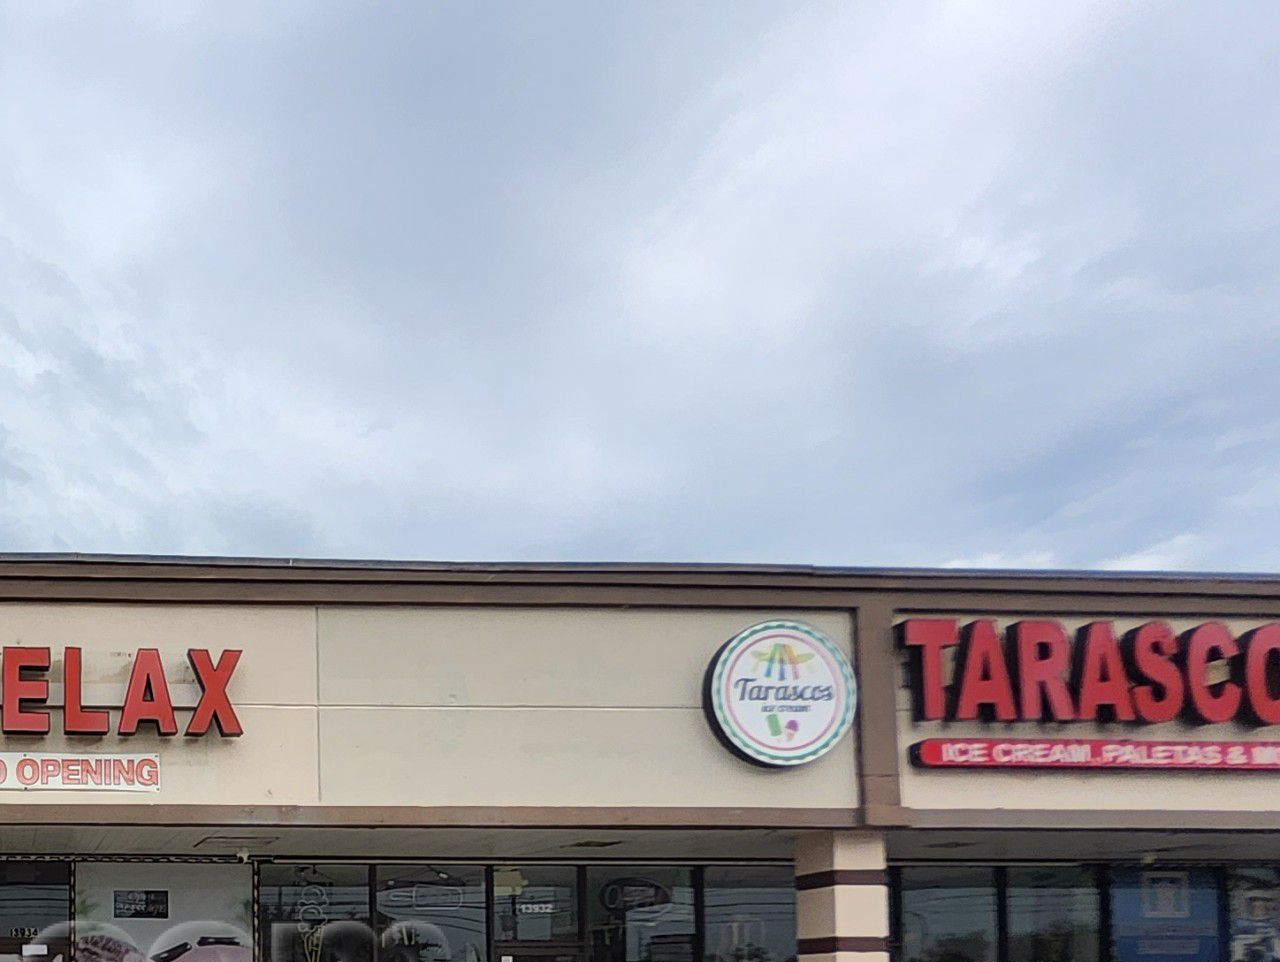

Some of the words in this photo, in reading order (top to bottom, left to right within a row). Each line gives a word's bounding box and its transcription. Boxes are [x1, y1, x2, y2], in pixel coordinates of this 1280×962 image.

[941, 743, 989, 762] ICE
[16, 757, 160, 787] OPENING
[10, 928, 38, 937] 13934
